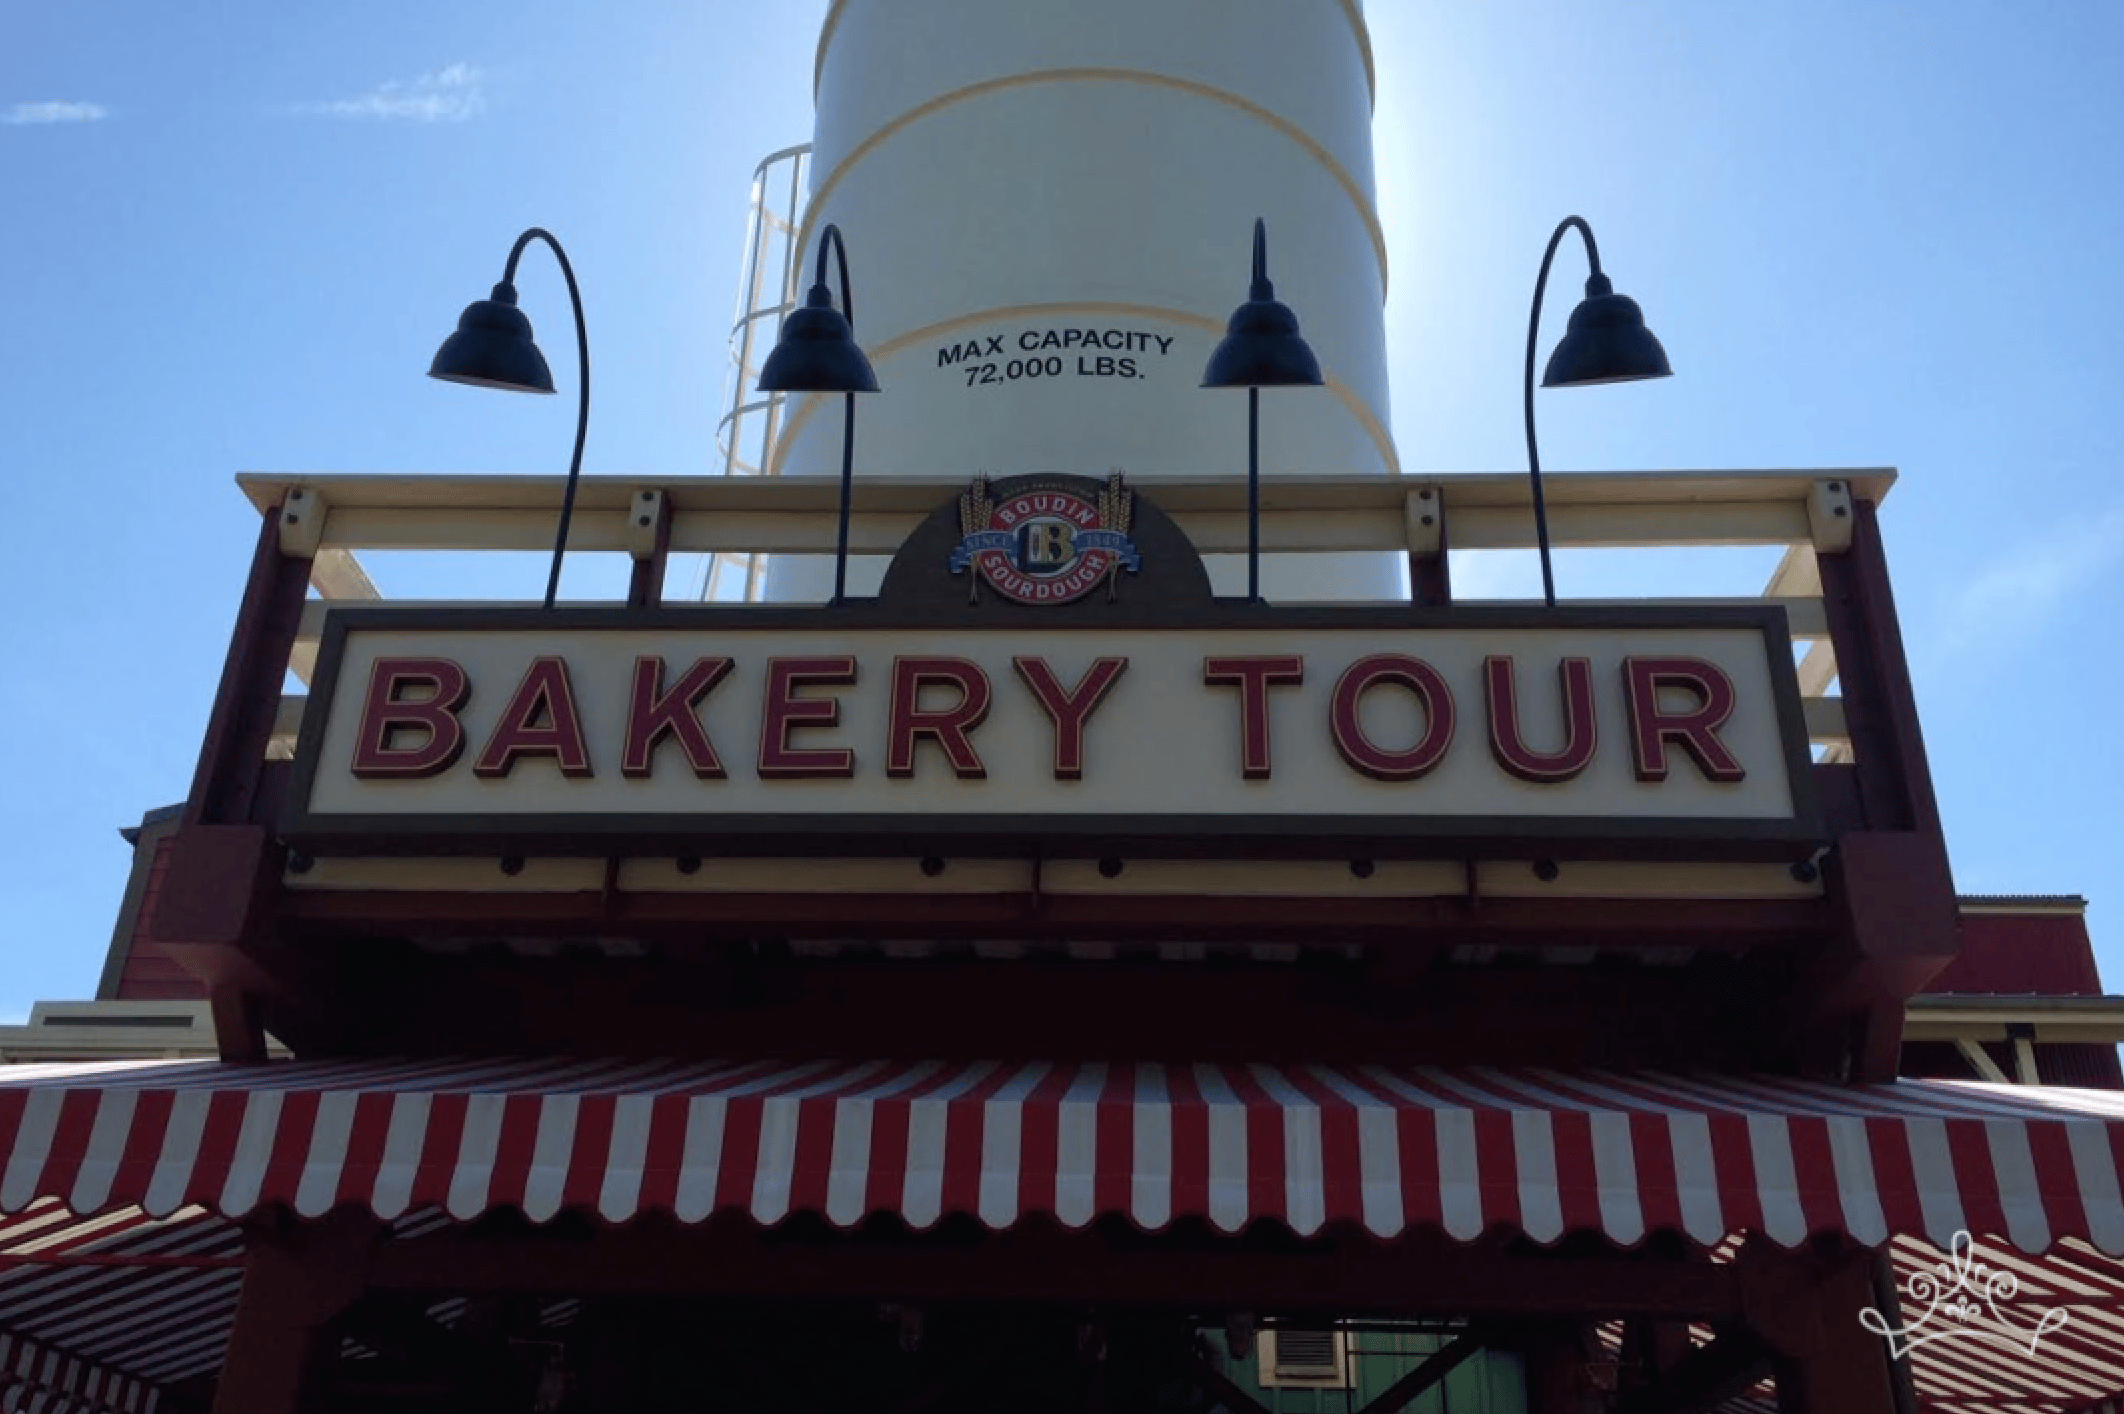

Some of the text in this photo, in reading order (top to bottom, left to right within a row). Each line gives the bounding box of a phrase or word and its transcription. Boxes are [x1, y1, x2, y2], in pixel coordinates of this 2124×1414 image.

[937, 328, 1174, 367] MAX CAPACITY
[965, 356, 1146, 387] 72,000 LBS.
[1000, 496, 1094, 524] BOUDIN
[984, 554, 1105, 598] SOURDOUGH
[351, 653, 1746, 783] BAKERY TOUR
